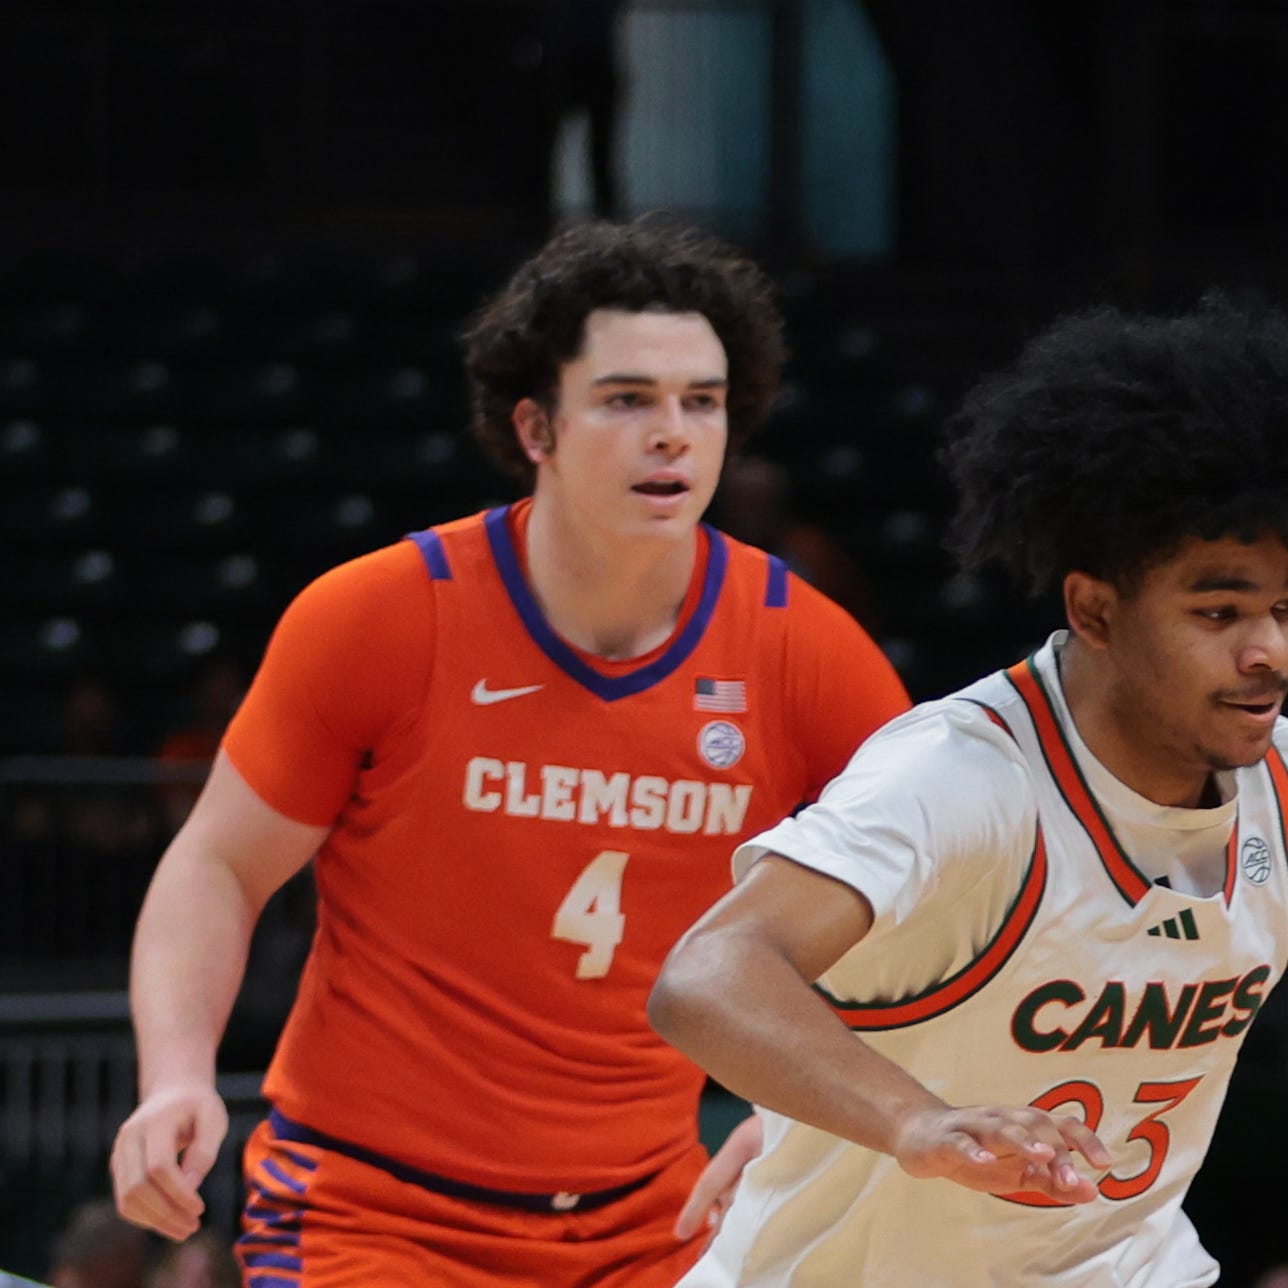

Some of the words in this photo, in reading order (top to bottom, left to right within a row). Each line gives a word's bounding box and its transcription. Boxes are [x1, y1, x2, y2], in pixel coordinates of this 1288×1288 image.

[463, 757, 753, 835] CLEMSON
[1244, 849, 1268, 866] ACC
[550, 851, 630, 979] 4
[1010, 964, 1272, 1053] CANES
